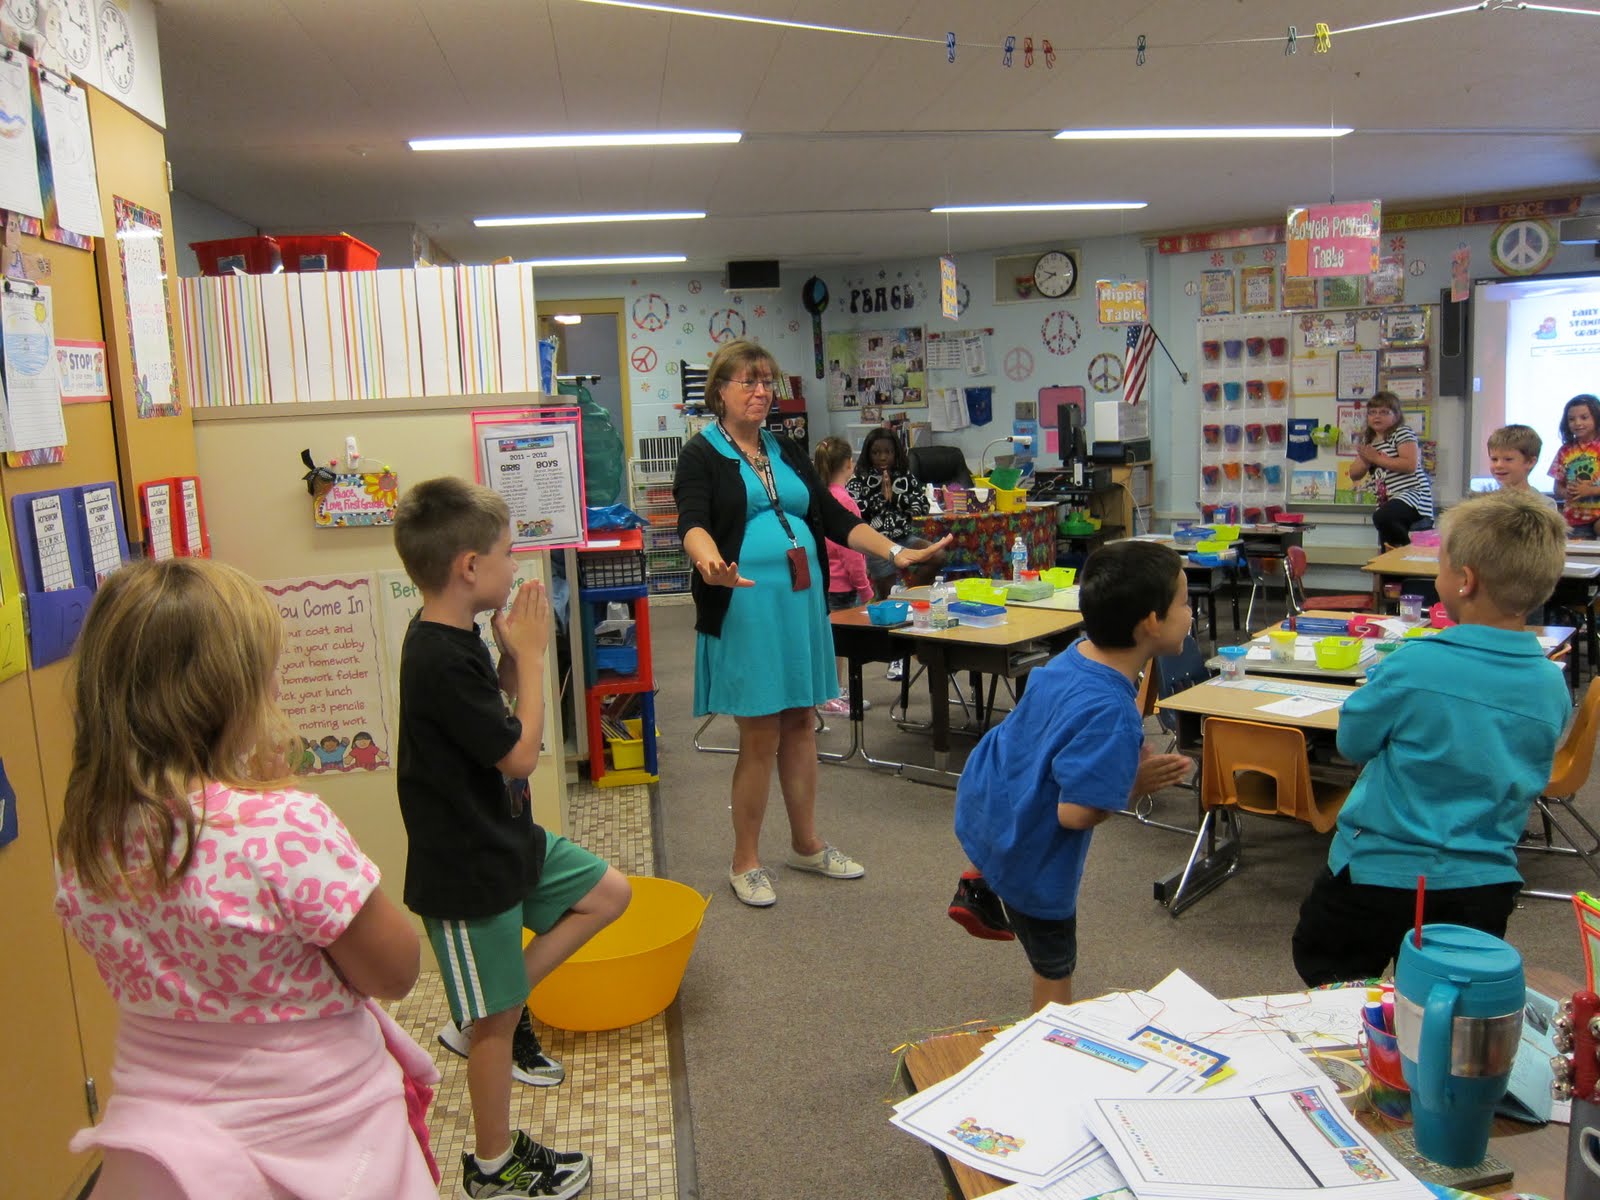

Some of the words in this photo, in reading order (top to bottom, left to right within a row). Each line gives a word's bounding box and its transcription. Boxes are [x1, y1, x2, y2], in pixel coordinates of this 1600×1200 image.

[850, 284, 914, 313] PEACE
[1105, 308, 1142, 321] Table
[69, 353, 93, 370] STOP!
[536, 460, 559, 469] BOYS
[278, 604, 299, 619] ou
[303, 598, 342, 619] Come
[347, 595, 364, 615] In
[305, 626, 330, 637] coat
[334, 624, 353, 634] and
[304, 643, 329, 657] your
[333, 638, 365, 652] cubby
[281, 661, 305, 674] your
[308, 655, 361, 668] homework
[282, 673, 333, 685] homework
[336, 669, 369, 681] folder
[298, 690, 322, 704] your
[325, 685, 353, 697] lunch
[309, 703, 327, 713] 2-3
[330, 700, 365, 715] pencils
[299, 719, 340, 731] morning
[342, 716, 368, 727] work
[1081, 1043, 1106, 1057] Things
[1107, 1052, 1116, 1060] to
[1117, 1057, 1130, 1065] Do
